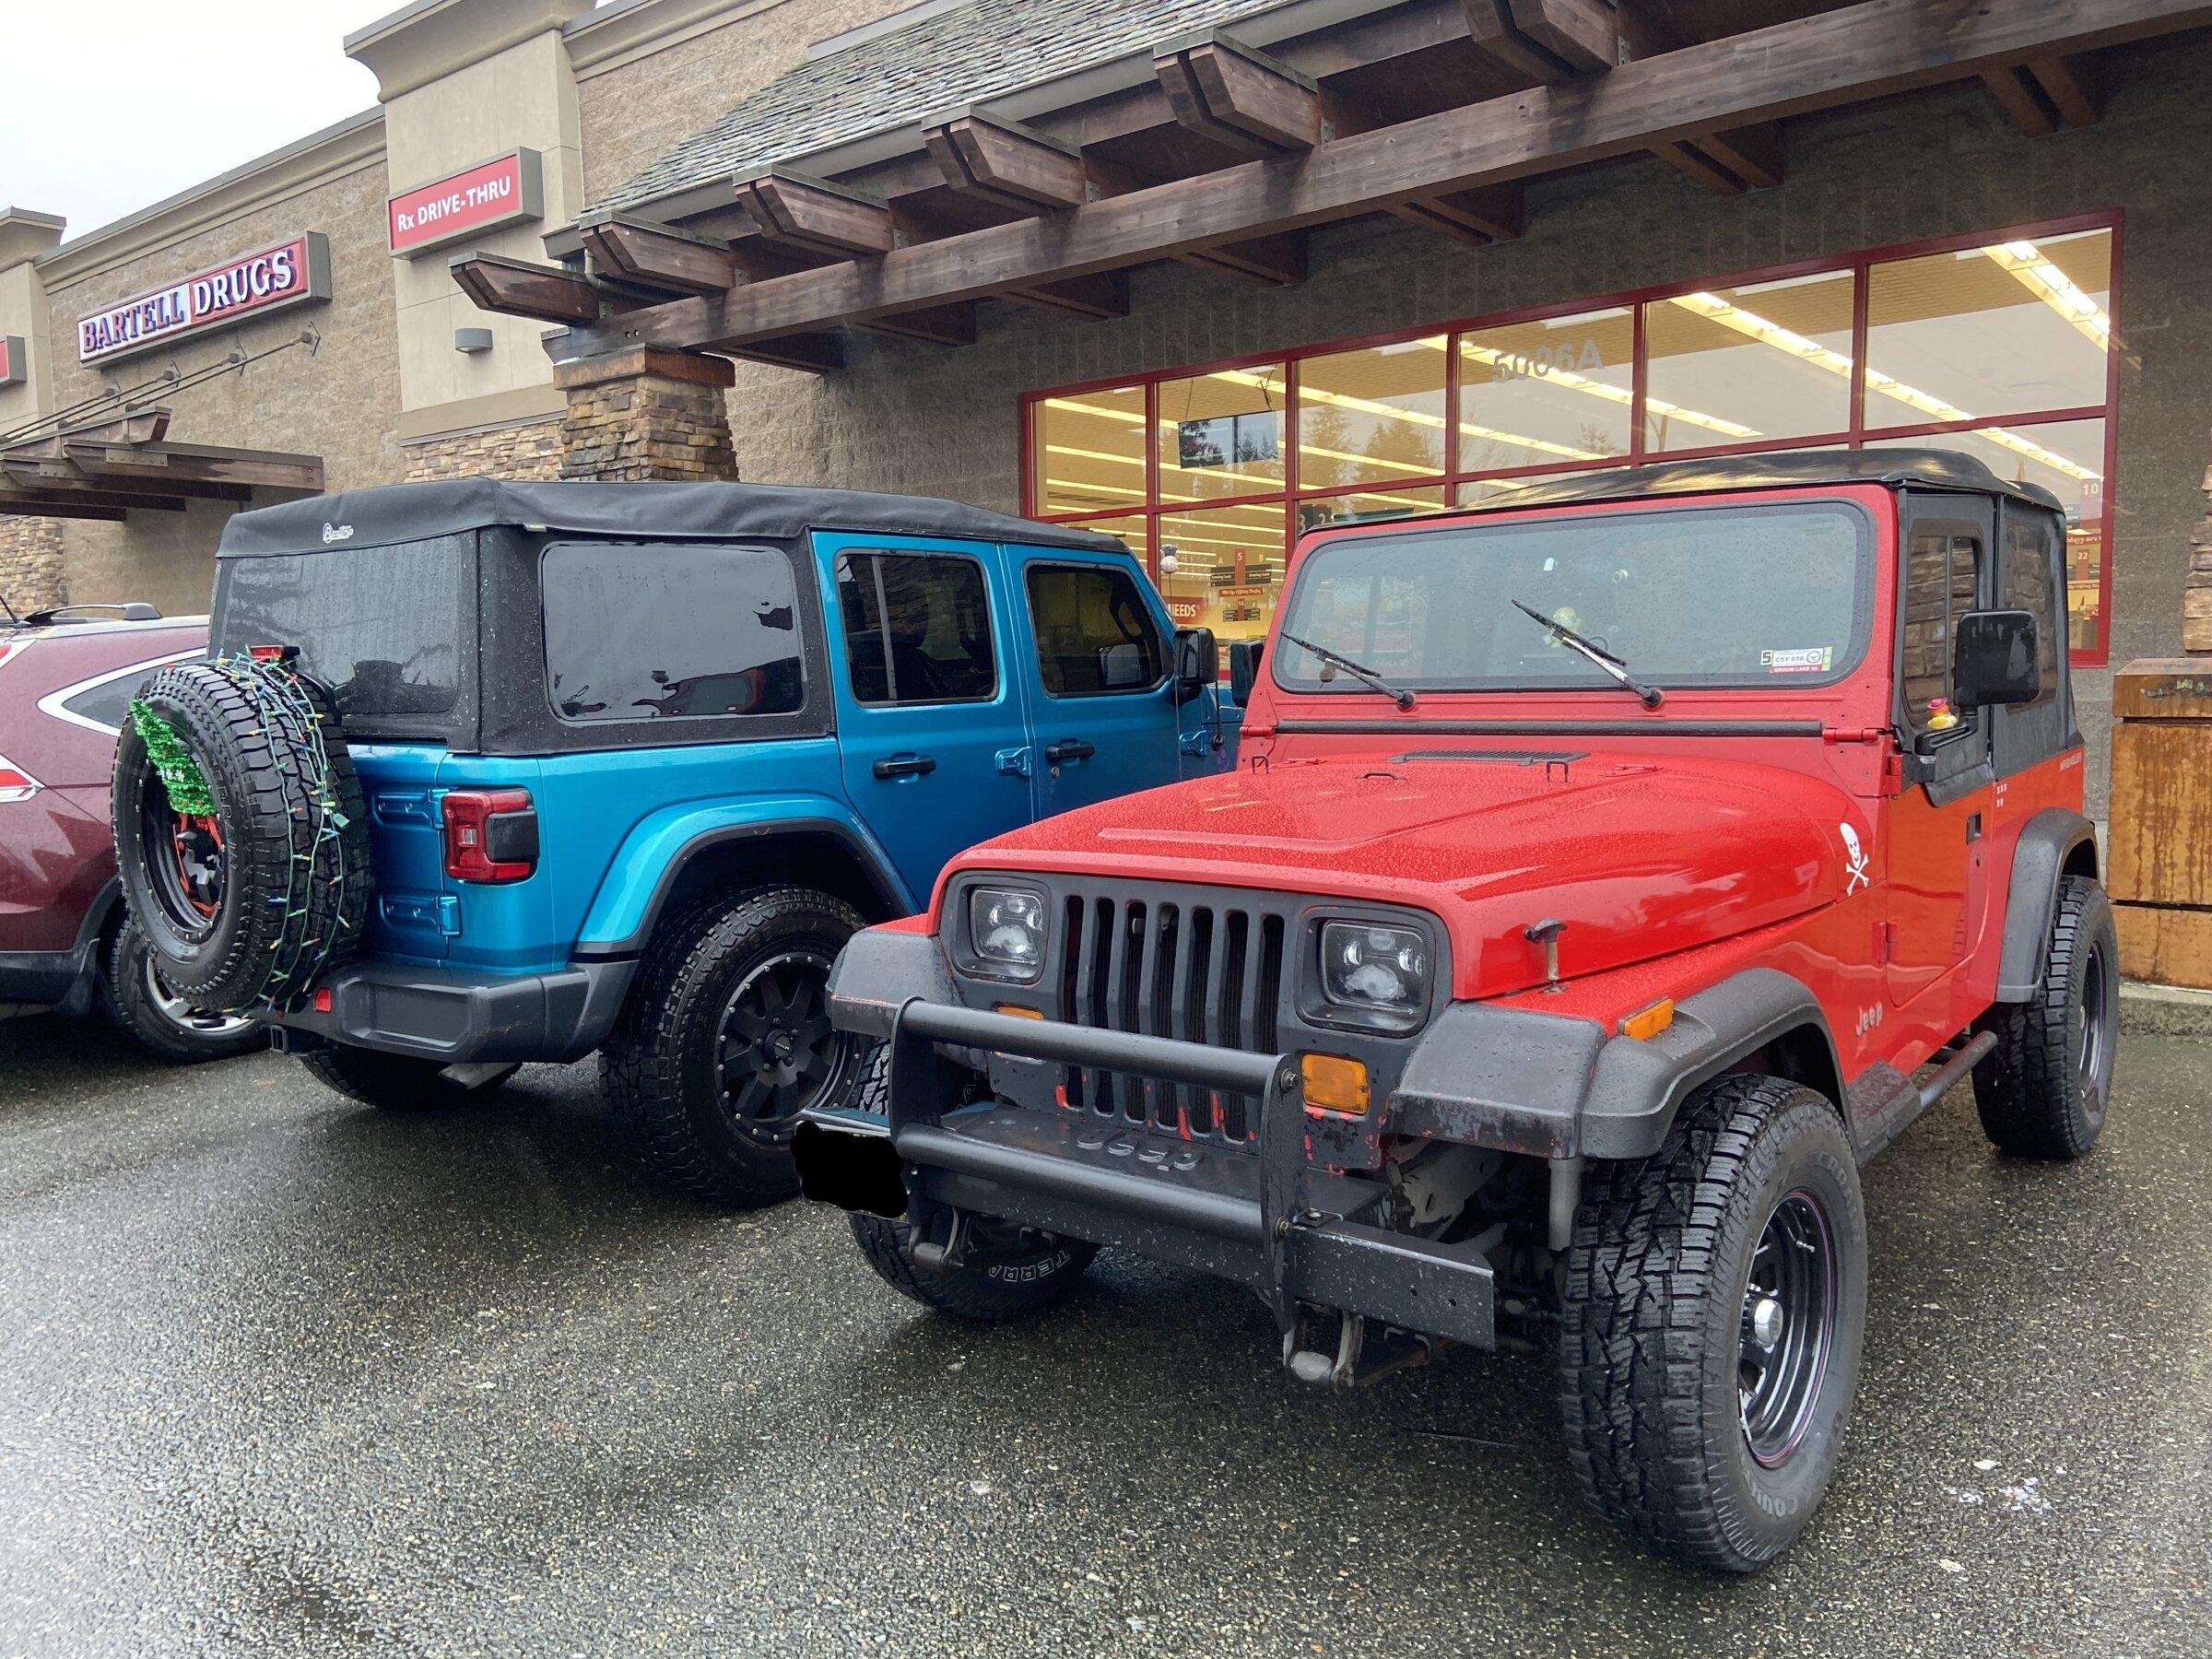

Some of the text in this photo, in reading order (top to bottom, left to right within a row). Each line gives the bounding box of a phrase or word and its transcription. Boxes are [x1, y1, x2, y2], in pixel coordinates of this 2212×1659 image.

[397, 175, 511, 232] Rx DRIVE-THRU
[82, 249, 296, 353] BARTELL DRUGS
[1492, 338, 1604, 383] 5006A
[2082, 483, 2100, 495] 10
[1237, 552, 1242, 561] 5
[2077, 552, 2088, 560] 22
[1761, 651, 1771, 664] 5
[1855, 1000, 1884, 1038] Jeep
